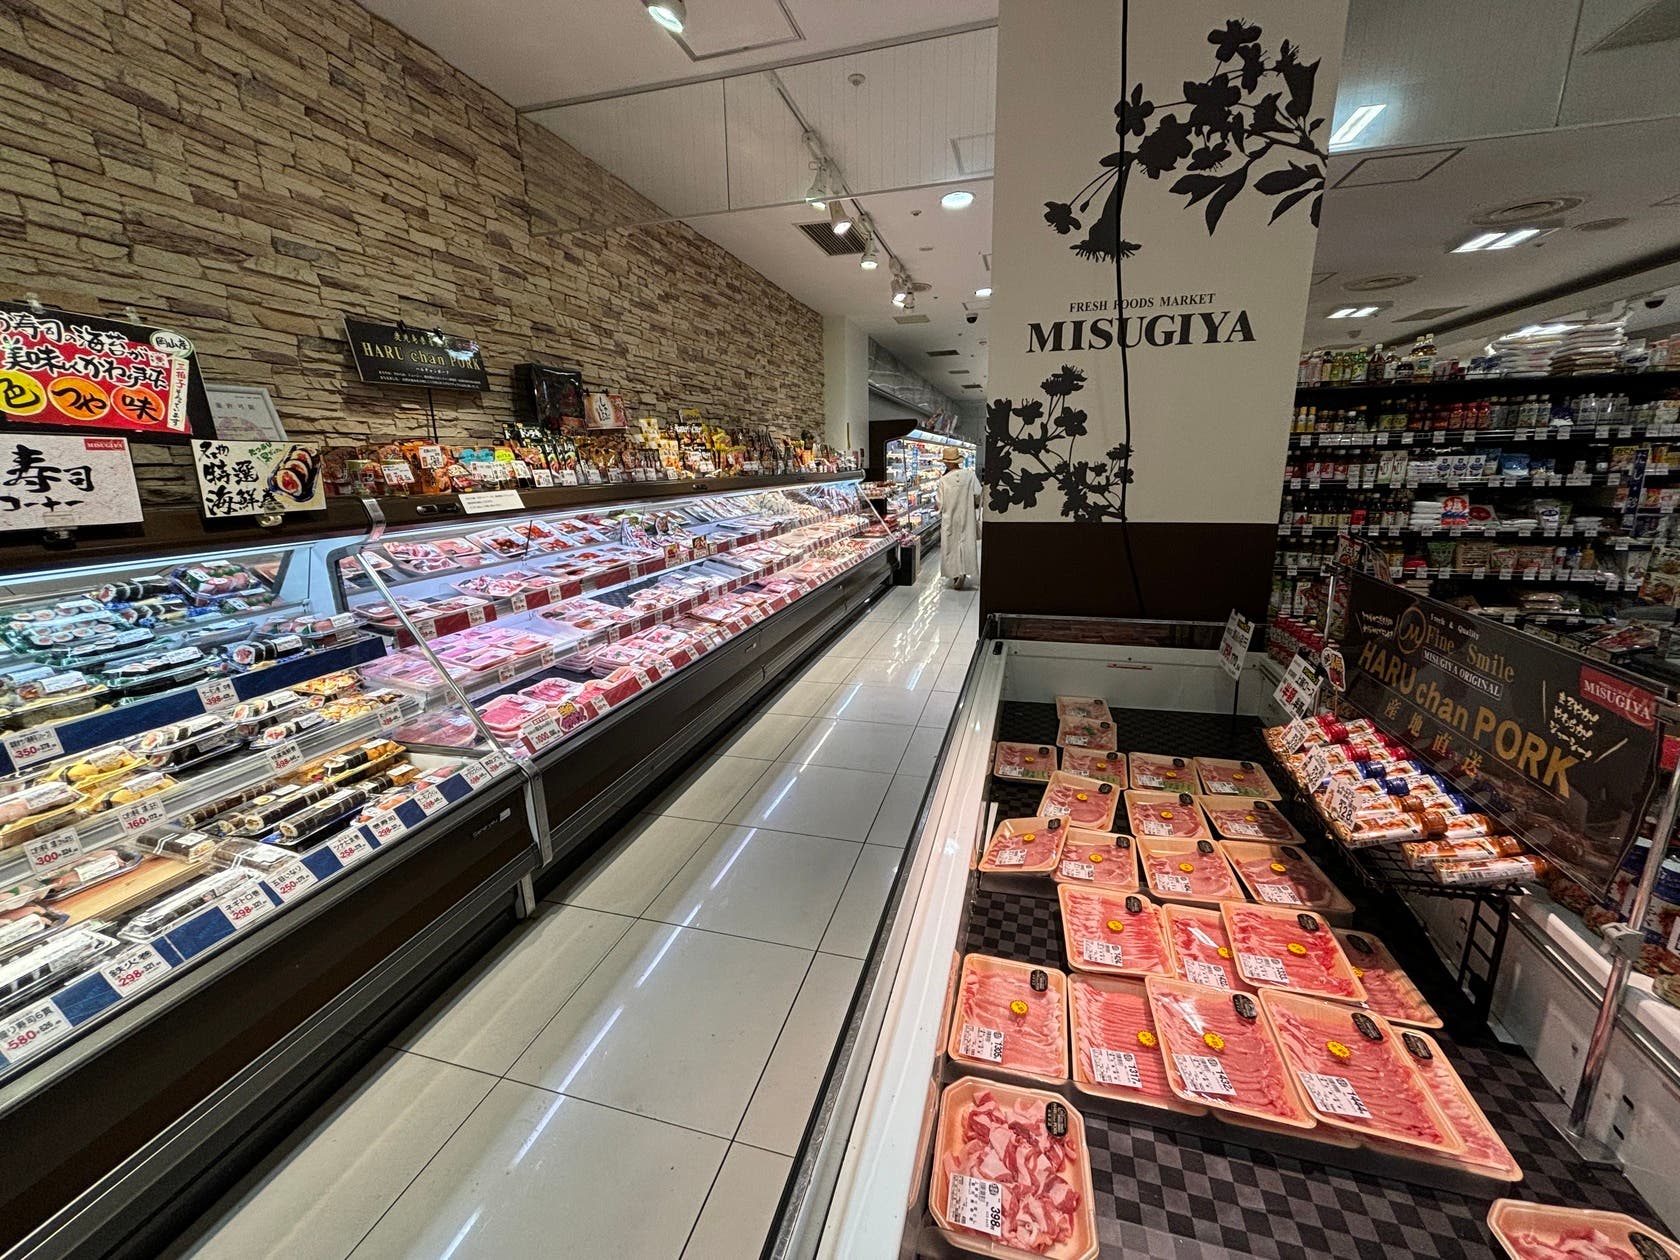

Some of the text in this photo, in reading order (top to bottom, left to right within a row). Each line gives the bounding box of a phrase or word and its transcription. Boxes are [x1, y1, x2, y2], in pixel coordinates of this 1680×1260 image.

[1069, 292, 1216, 313] FRESH FOODS MARKET
[1026, 309, 1256, 353] MISUGIYA
[361, 342, 480, 370] HARU chan PORK
[0, 378, 41, 408] 色
[51, 387, 108, 414] つや
[121, 394, 160, 421] 味
[3, 444, 95, 493] 寿司
[203, 459, 259, 485] 特選
[0, 496, 84, 512] コーナー
[1425, 624, 1455, 655] Fine
[1466, 643, 1516, 683] Smile
[1424, 650, 1500, 697] MISUGIYA ORIGINAL
[1584, 680, 1650, 720] MISUGIYA
[1358, 641, 1418, 693] HARU
[1416, 677, 1468, 731] chan
[1473, 705, 1580, 799] PORK
[15, 746, 38, 758] 350
[128, 817, 147, 829] 160
[36, 852, 59, 865] 300
[280, 881, 298, 894] 250
[232, 906, 252, 920] 298
[119, 969, 143, 987] 298
[8, 1030, 37, 1050] 580
